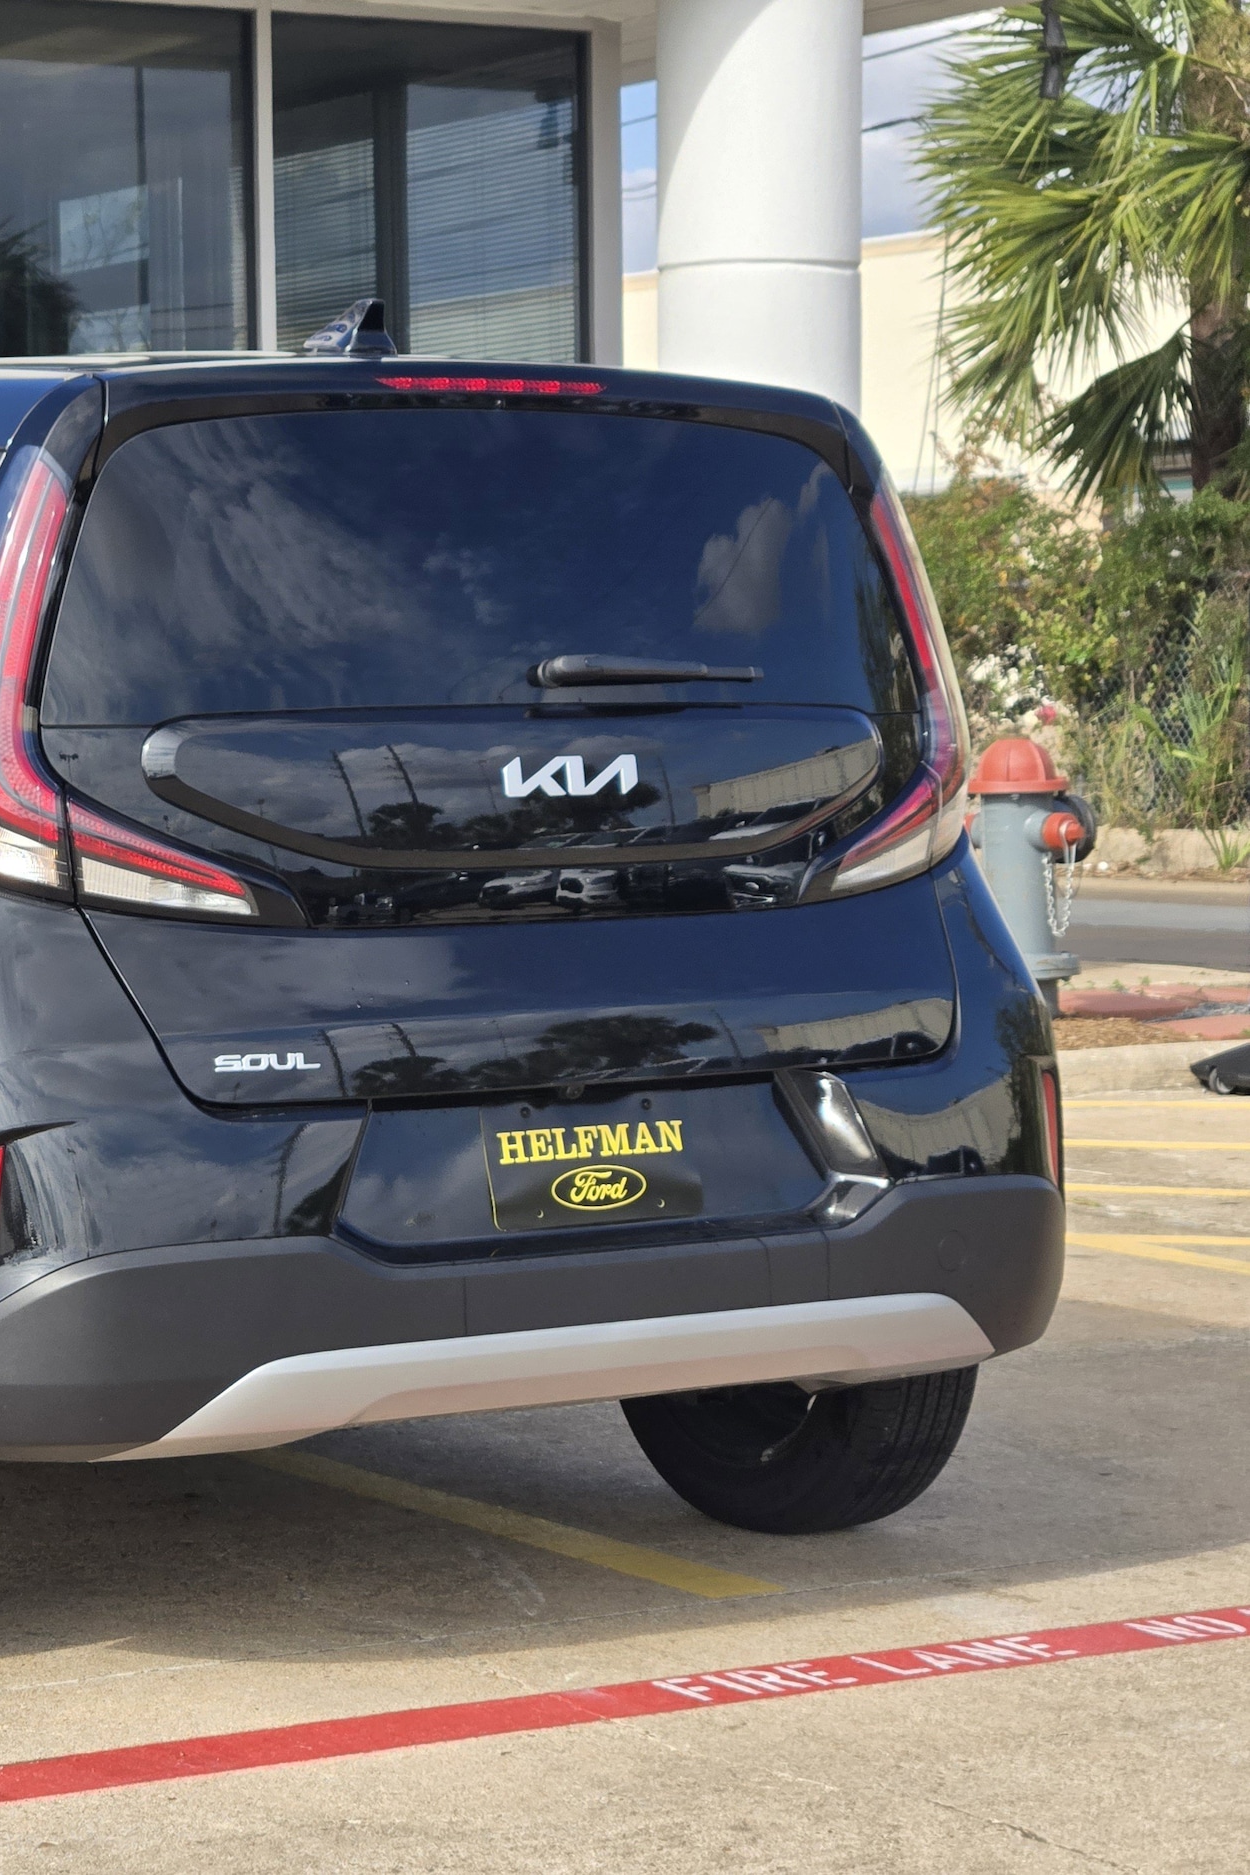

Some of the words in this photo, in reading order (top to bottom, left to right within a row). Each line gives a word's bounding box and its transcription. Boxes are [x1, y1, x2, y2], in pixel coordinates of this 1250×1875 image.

[502, 753, 639, 798] KIA
[214, 1052, 321, 1073] SOUL
[496, 1119, 684, 1165] HELFMAN
[570, 1170, 628, 1203] Ford
[652, 1662, 859, 1701] FIRE
[851, 1635, 1079, 1676] LANE
[1123, 1615, 1248, 1641] NO
